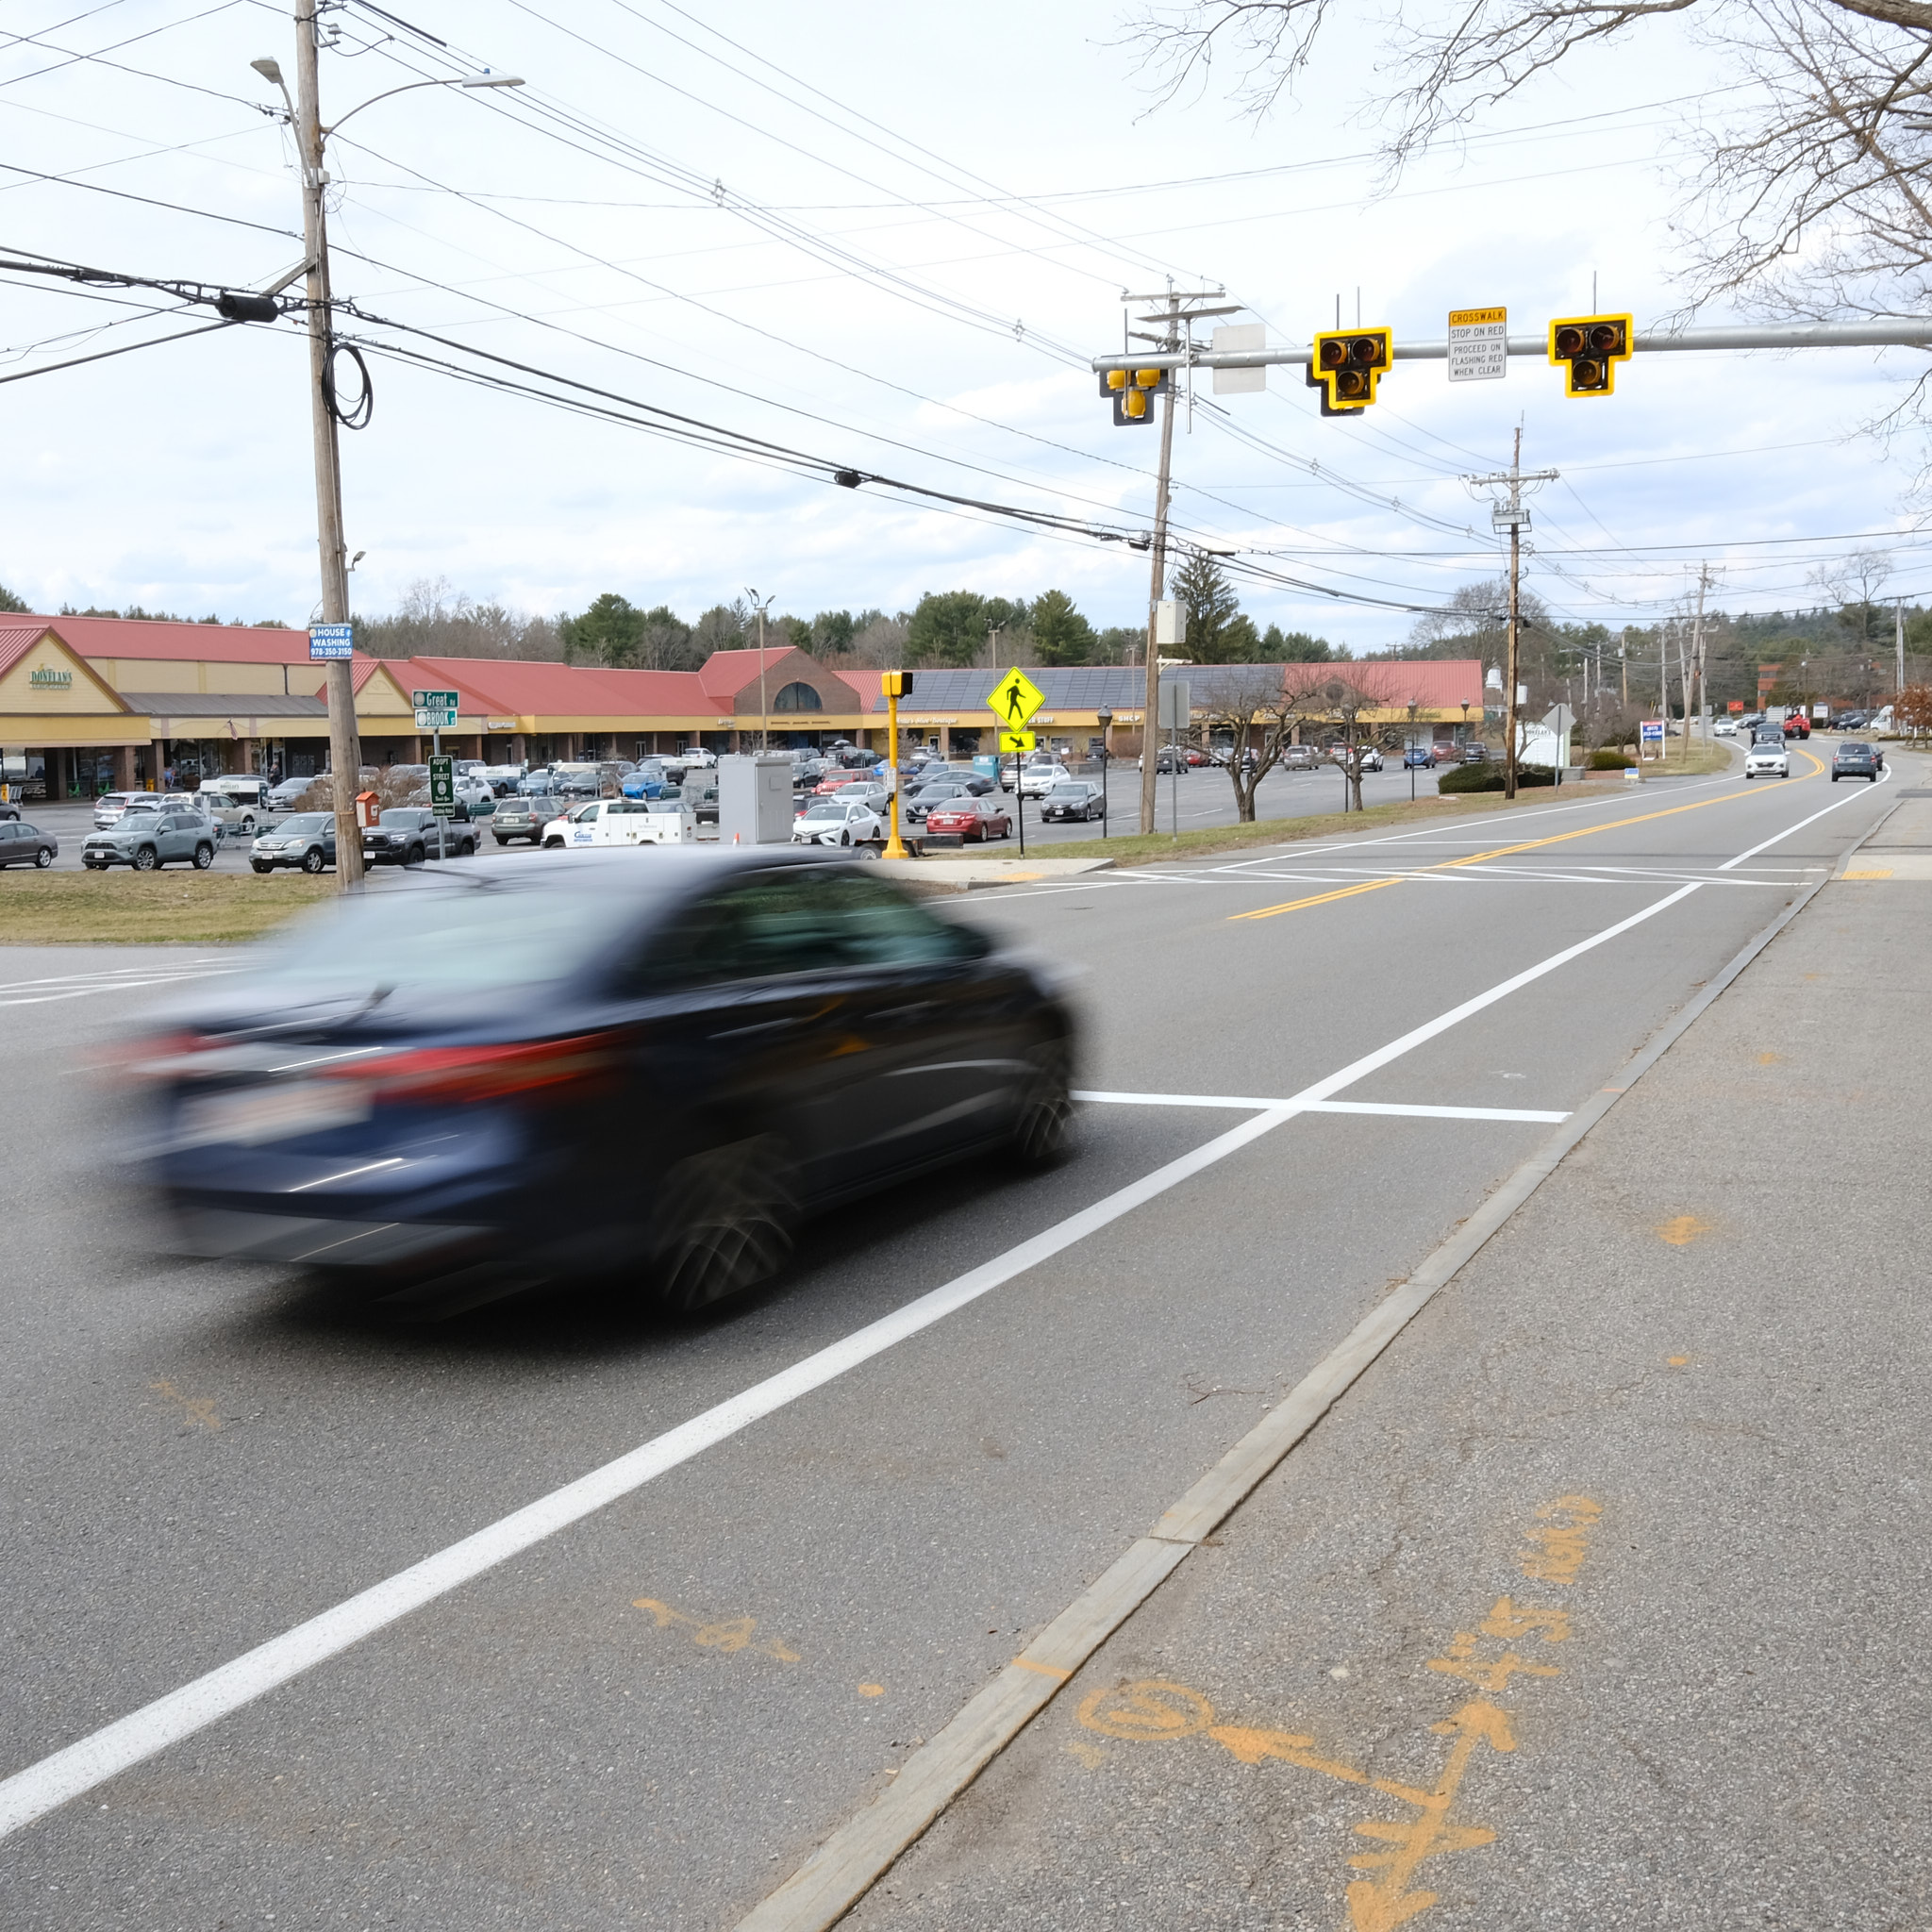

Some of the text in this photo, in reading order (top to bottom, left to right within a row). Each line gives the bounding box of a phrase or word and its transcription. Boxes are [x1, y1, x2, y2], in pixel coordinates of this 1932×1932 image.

[1452, 310, 1504, 323] CROSSWALK
[1452, 326, 1504, 338] STOP ON RED
[1455, 344, 1487, 354] PROCEED
[1452, 356, 1486, 365] FLASHING
[1478, 365, 1500, 374] CLEAR
[312, 638, 351, 646] WASHING
[426, 692, 447, 706] Great
[426, 711, 449, 724] BROOK
